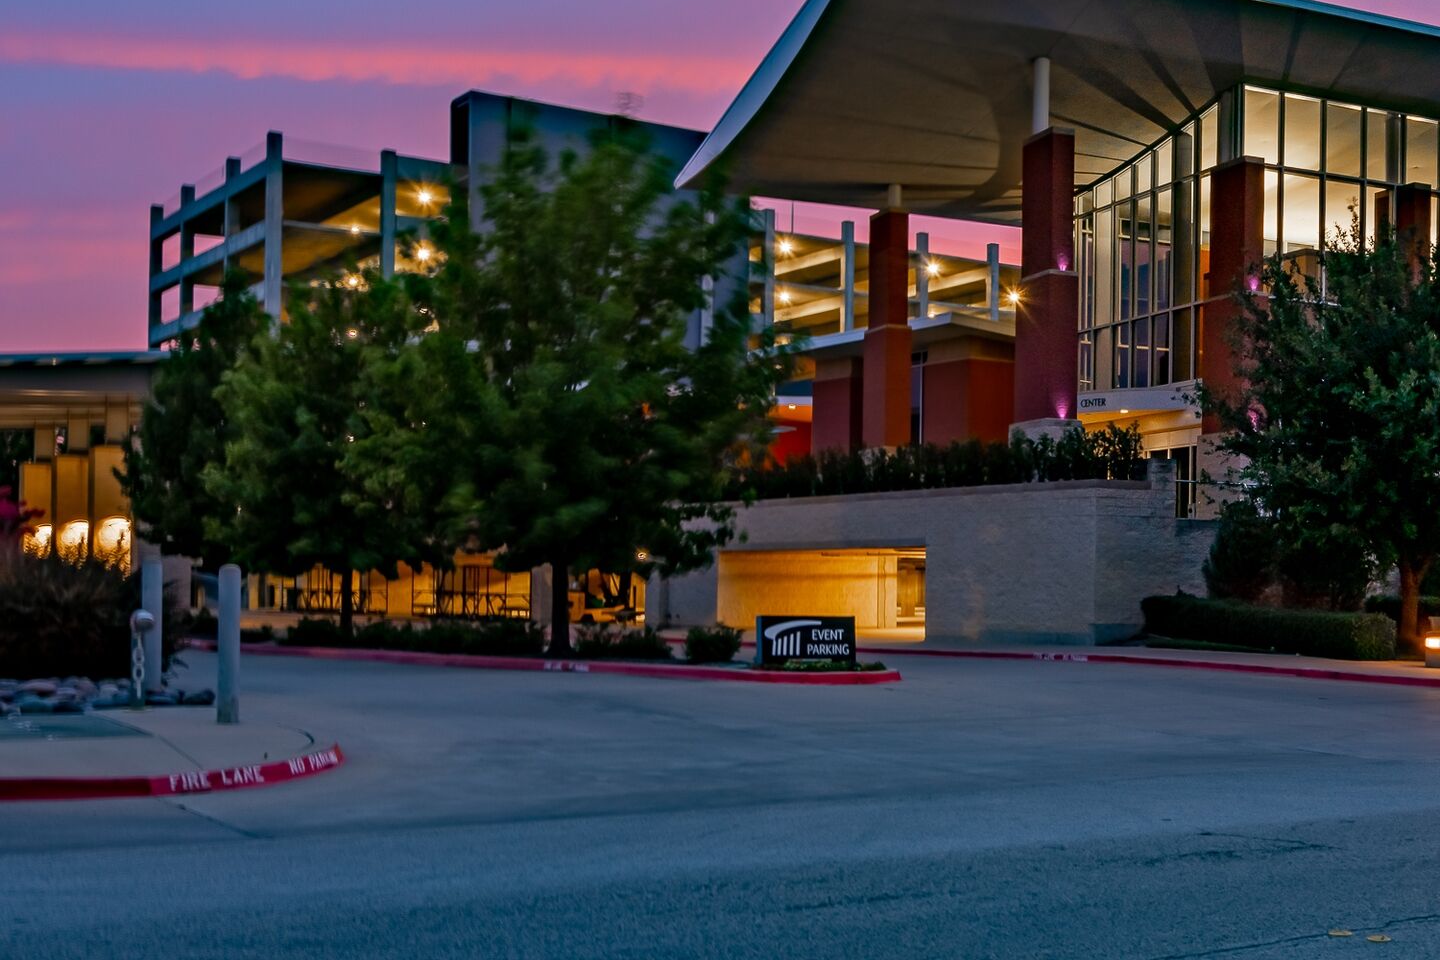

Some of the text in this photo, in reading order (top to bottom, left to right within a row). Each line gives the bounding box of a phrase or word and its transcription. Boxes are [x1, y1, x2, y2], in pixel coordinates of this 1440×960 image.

[1080, 398, 1107, 408] CENTER
[812, 629, 844, 640] EVENT
[807, 644, 849, 655] PARKING
[169, 771, 211, 791] FIRE
[221, 765, 264, 785] LANE
[289, 757, 305, 774] NO
